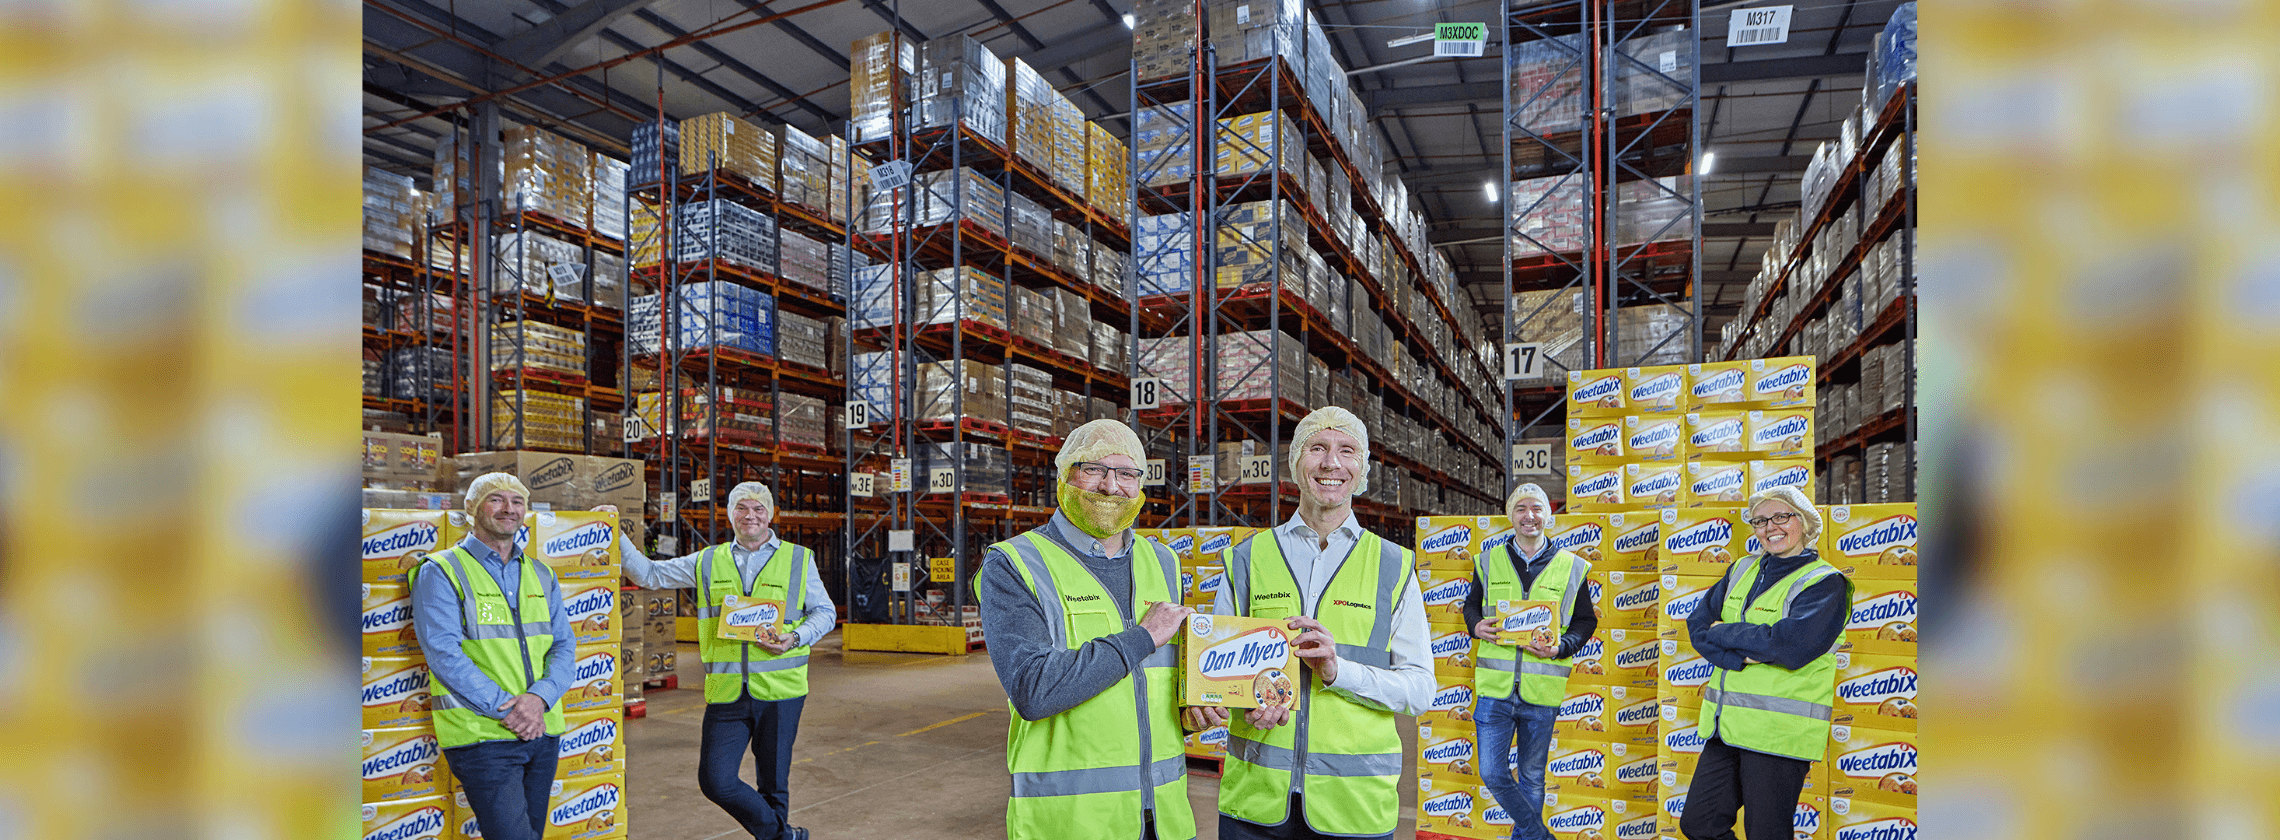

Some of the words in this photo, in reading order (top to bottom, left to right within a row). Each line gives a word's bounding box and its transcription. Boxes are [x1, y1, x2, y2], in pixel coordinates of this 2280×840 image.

[1746, 10, 1776, 26] M317
[1440, 26, 1478, 39] M3XDOC
[1511, 346, 1537, 374] 17
[1574, 379, 1621, 400] Weetabix
[1632, 376, 1682, 399] Weetabix
[1694, 371, 1745, 395] Weetabix
[1757, 367, 1810, 391] Weetabix
[1135, 381, 1155, 405] 18
[849, 403, 865, 425] 19
[626, 420, 640, 439] 20
[1573, 427, 1619, 448] Weetabix
[1631, 425, 1681, 448] Weetabix
[1692, 421, 1743, 444] Weetabix
[1756, 418, 1808, 442] Weetabix
[1147, 463, 1162, 480] 3D
[1693, 471, 1744, 493] Weetabix
[1573, 475, 1619, 495] Weetabix
[1632, 473, 1681, 495] Weetabix
[362, 527, 438, 555] Weetabix
[547, 527, 614, 553] Weetabix
[1170, 537, 1194, 552] eetabix
[1200, 536, 1231, 553] Weetabix
[1423, 528, 1472, 551] Weetabix
[1551, 526, 1603, 550] Weetabix
[1616, 526, 1659, 551] Weetab
[1668, 523, 1733, 550] Weetabix
[1840, 522, 1917, 551] Weetabix
[1065, 594, 1100, 602] Weetabix
[1253, 591, 1291, 602] Weetabix
[1423, 581, 1472, 603] Weetabix
[1616, 584, 1659, 608] Weetab
[564, 591, 615, 617] eetabix
[1851, 598, 1917, 624] eetabix
[730, 611, 757, 626] Stewart
[757, 608, 776, 621] Potts
[1504, 616, 1525, 629] Matthew
[1525, 611, 1550, 625] Middleton
[1431, 634, 1472, 655] eetabix
[1617, 643, 1660, 665] Weetab
[1202, 650, 1236, 673] Dan
[1238, 641, 1287, 668] Myers
[576, 657, 615, 680] tabix
[1668, 660, 1714, 682] Weetab
[1432, 689, 1472, 706] eetabix
[1840, 674, 1917, 699] Weetabix
[1559, 697, 1604, 716] eetabix
[1668, 732, 1705, 747] Weeta
[362, 742, 437, 777] Weetabix
[1424, 743, 1473, 761] Weetabix
[1840, 751, 1917, 772] Weetabix
[1549, 754, 1605, 773] Weetabix
[553, 786, 618, 825] Weetabix
[1424, 796, 1473, 813] Weetabix
[1485, 806, 1509, 820] Weet
[1549, 811, 1605, 829] Weetabix
